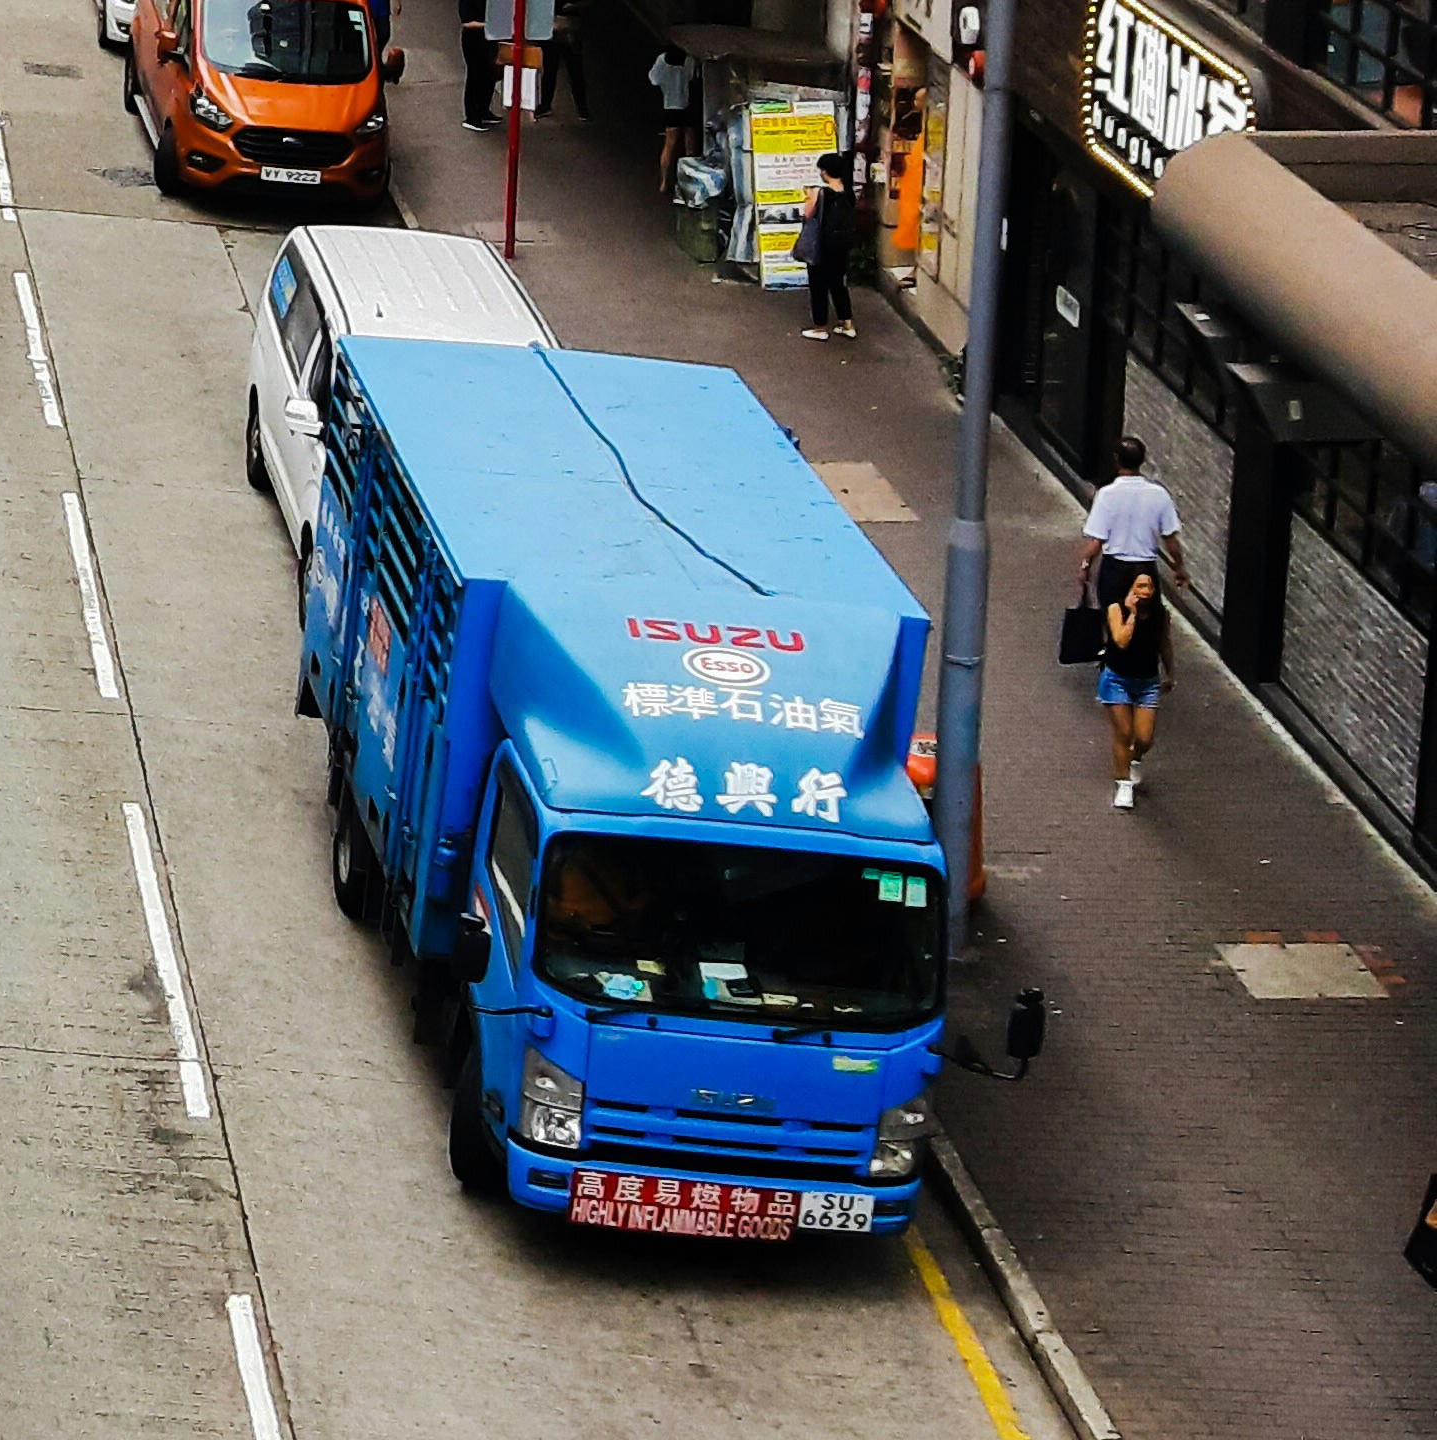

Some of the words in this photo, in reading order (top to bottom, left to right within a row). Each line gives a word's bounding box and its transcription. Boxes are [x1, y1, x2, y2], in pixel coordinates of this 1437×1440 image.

[626, 617, 805, 652] ISUZU
[621, 681, 865, 741] 標準石油氣
[640, 756, 847, 824] 德興行
[577, 1170, 797, 1217] 高度易燃物品
[820, 1194, 856, 1212] SU
[571, 1198, 628, 1229] HIGHLY
[737, 1216, 794, 1241] GOODS
[802, 1210, 868, 1230] 6629
